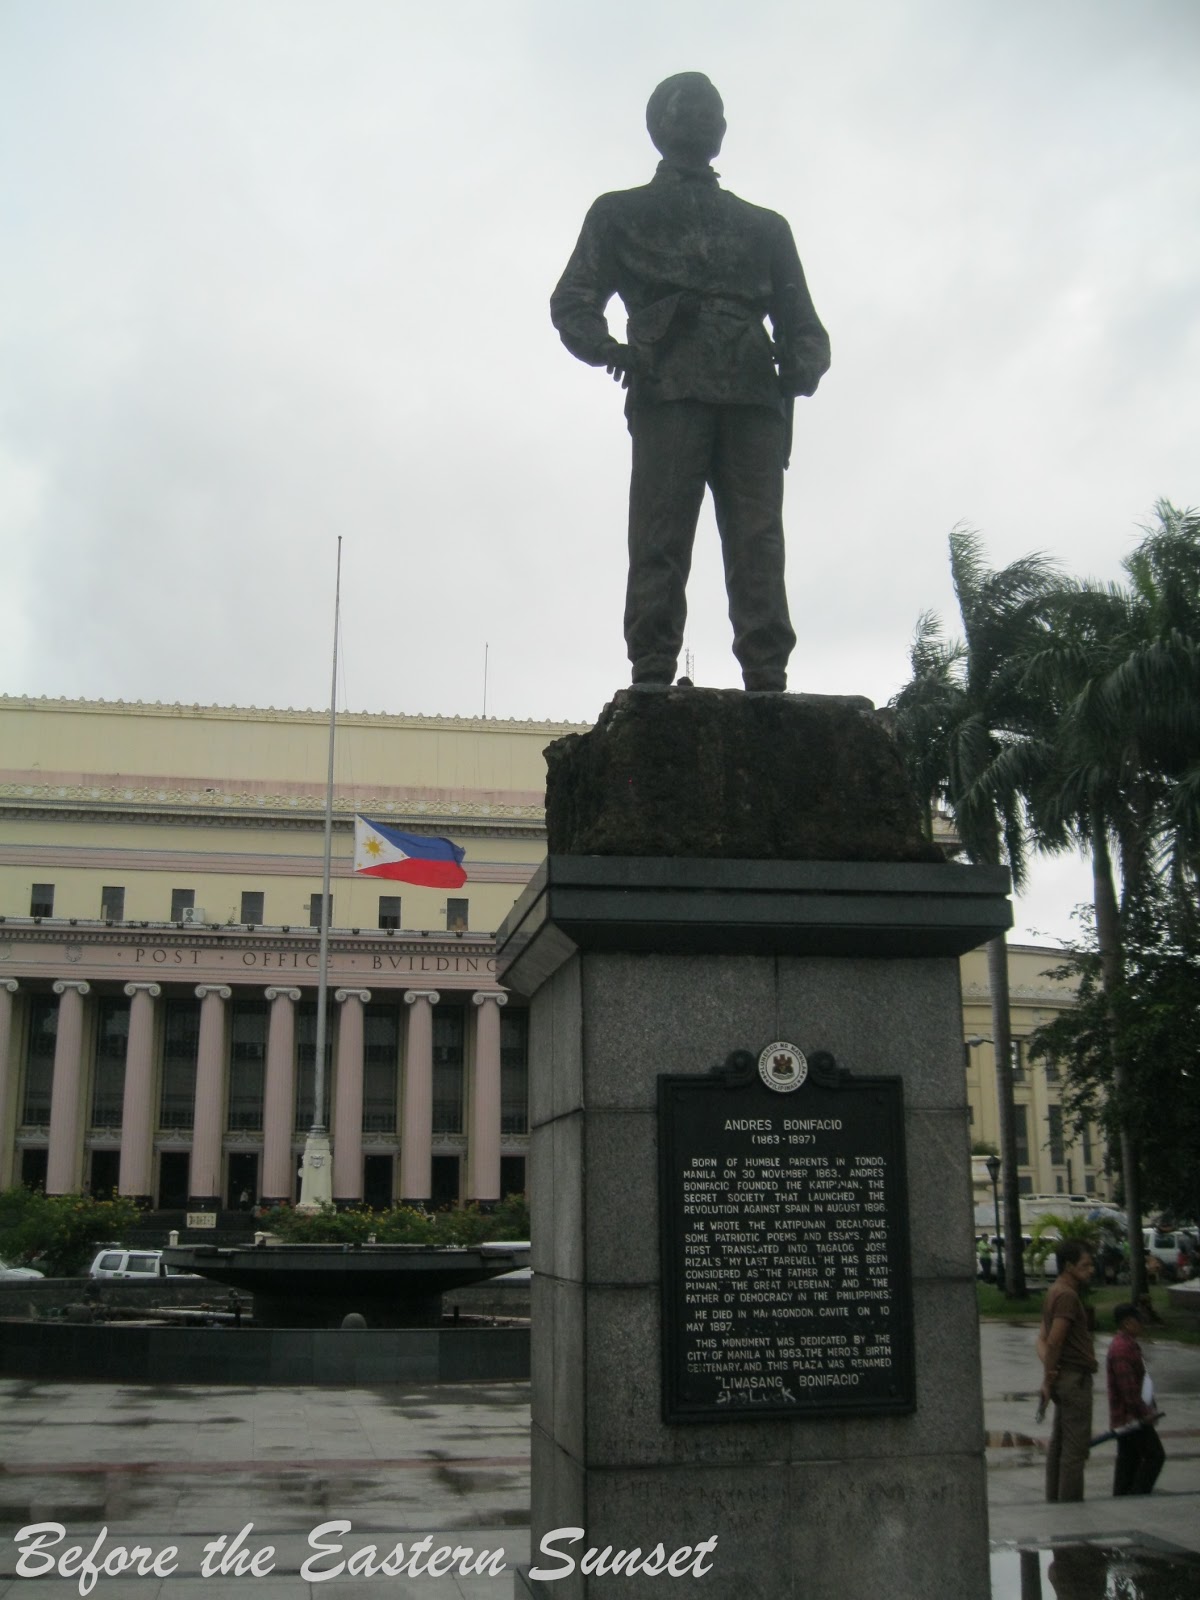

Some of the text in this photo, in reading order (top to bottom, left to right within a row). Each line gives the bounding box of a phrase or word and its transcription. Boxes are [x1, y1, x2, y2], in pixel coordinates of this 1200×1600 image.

[135, 948, 202, 964] POST
[242, 952, 334, 969] OFFICE
[724, 1118, 843, 1131] ANDRES BONIFACIO
[692, 1157, 718, 1167] BORN
[727, 1157, 738, 1167] OF
[745, 1156, 781, 1167] HUMBLE
[789, 1156, 829, 1167] PARENTS
[836, 1156, 846, 1167] IN
[683, 1169, 717, 1179] MANILA
[723, 1169, 737, 1179] ON
[742, 1168, 756, 1179] 30
[762, 1168, 809, 1179] NOVEMBER
[850, 1167, 885, 1178] ANDRES
[684, 1180, 731, 1191] BONIFACIO
[738, 1180, 779, 1191] FOUNDED
[786, 1180, 803, 1190] THE
[868, 1179, 886, 1189] THE
[684, 1190, 886, 1203] SECRET SOCIETY THAT LAUNCHED THE
[684, 1204, 740, 1215] REVOLUTION
[744, 1204, 781, 1214] AGAINST
[785, 1203, 811, 1214] SPAIN
[814, 1203, 824, 1213] IN
[827, 1203, 861, 1213] AUGUST
[694, 1221, 705, 1231] HE
[710, 1221, 741, 1231] WROTE
[749, 1220, 767, 1231] THE
[775, 1220, 827, 1230] KATIPUNAN
[685, 1233, 709, 1243] SOME
[715, 1232, 761, 1243] PATRIOTIC
[767, 1232, 798, 1242] POEMS
[804, 1231, 822, 1241] AND
[869, 1230, 888, 1240] AND
[685, 1245, 712, 1256] FIRST
[787, 1244, 809, 1254] INTO
[816, 1243, 856, 1254] TAGALOG
[746, 1256, 768, 1266] LAST
[824, 1255, 836, 1265] HE
[841, 1254, 860, 1265] HAS
[866, 1253, 889, 1264] BEEN
[685, 1269, 741, 1280] CONSIDERED
[747, 1269, 759, 1279] AS
[787, 1267, 819, 1278] FATHER
[825, 1267, 837, 1278] OF
[844, 1266, 859, 1277] THE
[754, 1280, 782, 1290] GREAT
[842, 1278, 861, 1289] AND
[685, 1293, 720, 1304] FATHER
[724, 1293, 736, 1304] OF
[740, 1291, 794, 1303] DEMOCRACY
[797, 1291, 808, 1302] IN
[813, 1291, 829, 1301] THE
[695, 1309, 708, 1320] HE
[712, 1309, 734, 1320] DIED
[738, 1309, 748, 1319] IN
[820, 1307, 850, 1317] CAVITE
[857, 1306, 871, 1316] ON
[880, 1305, 891, 1316] 10
[686, 1321, 736, 1333] MAY 1897.
[696, 1333, 892, 1348] THIS MONUMENT WAS DEDICATED BY THE
[687, 1350, 708, 1361] CITY
[712, 1350, 724, 1360] OF
[727, 1349, 762, 1360] MANILA
[766, 1348, 776, 1359] IN
[805, 1347, 824, 1358] THE
[865, 1345, 892, 1356] BIRTH
[744, 1361, 763, 1372] AND
[767, 1360, 789, 1371] THIS
[792, 1359, 824, 1370] PLAZA
[827, 1358, 846, 1369] WAS
[851, 1357, 893, 1368] RENAMED
